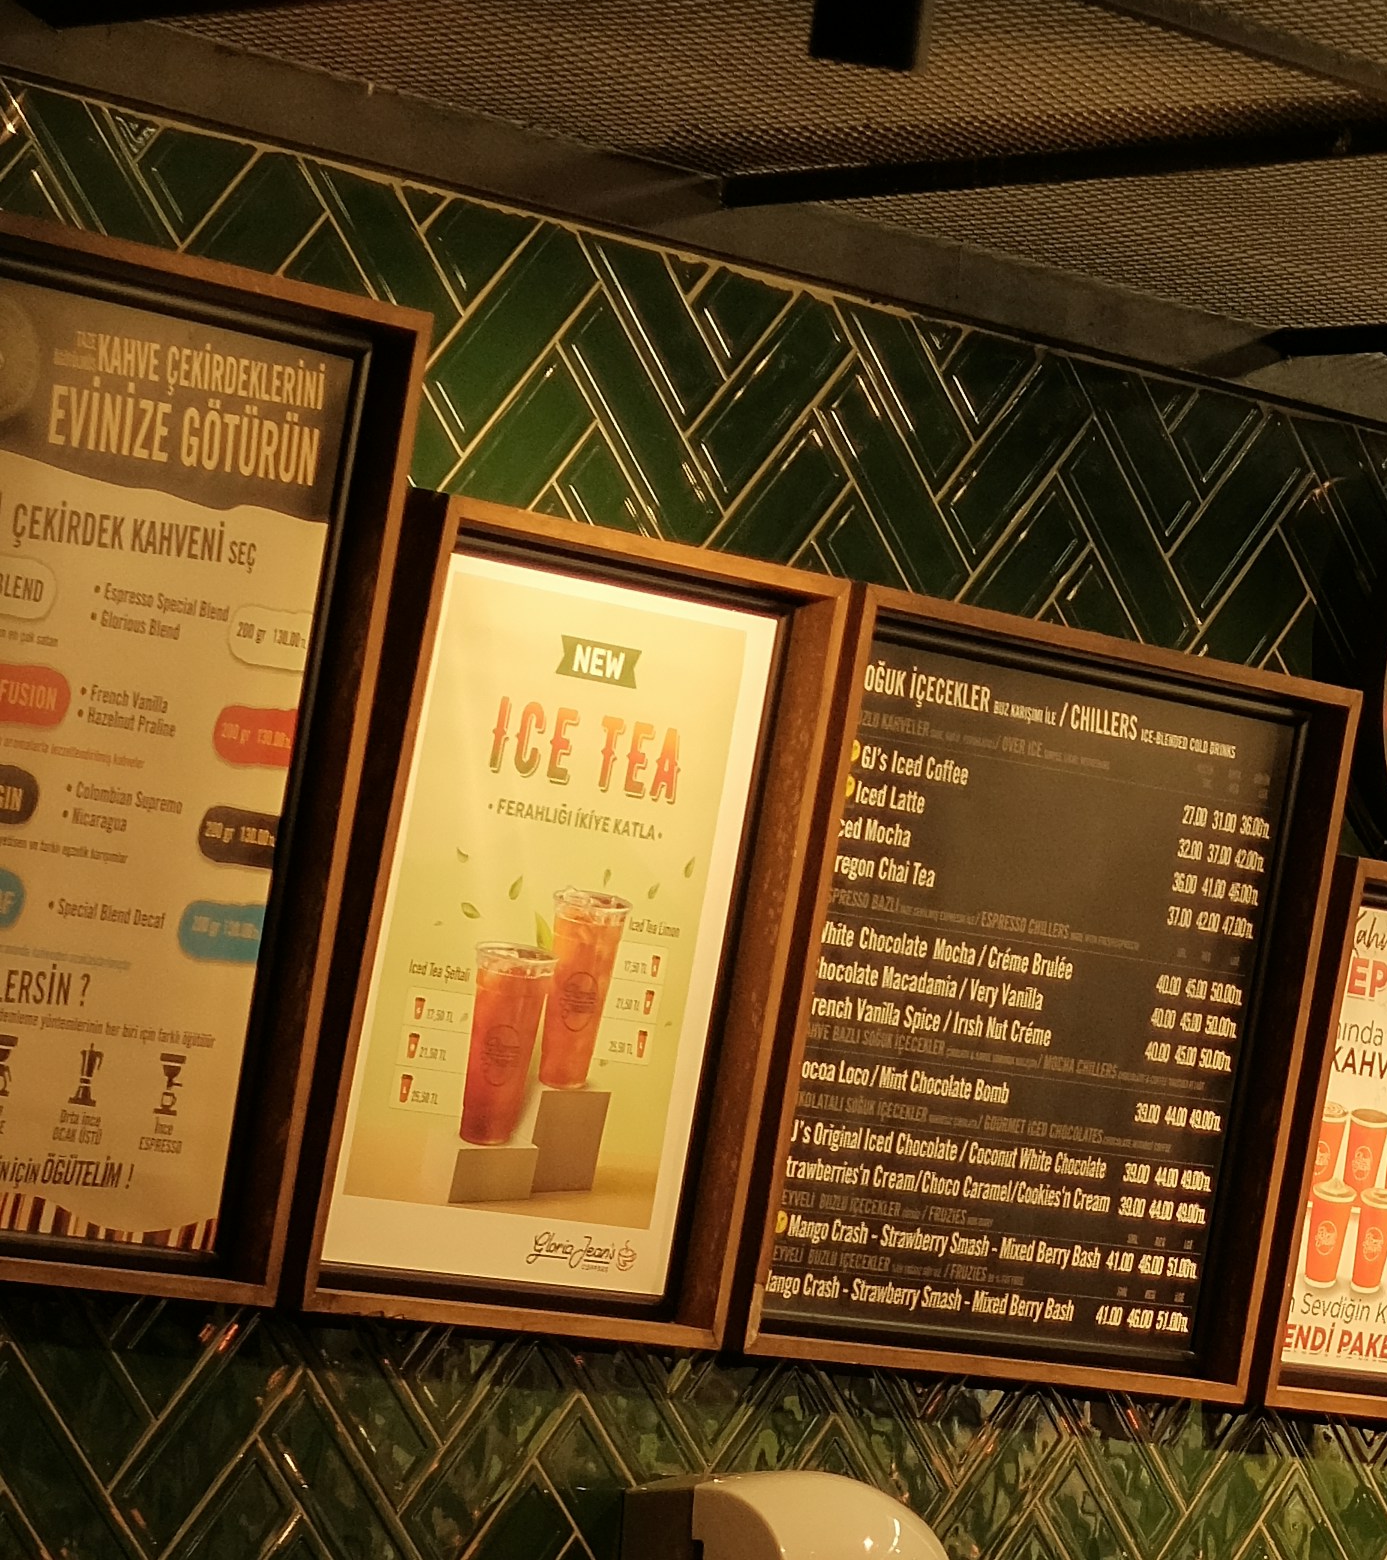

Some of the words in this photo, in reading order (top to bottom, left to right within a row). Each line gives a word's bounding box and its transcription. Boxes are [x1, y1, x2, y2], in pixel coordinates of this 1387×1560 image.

[98, 333, 160, 381] KAHVE
[167, 343, 326, 410] ÇEKİRDEKLERİNİ
[48, 376, 172, 462] EVİNİZE
[181, 399, 320, 487] GÖTÜRÜN
[12, 500, 126, 550] ÇEKİRDEK
[131, 517, 226, 563] KAHVENİ
[228, 540, 257, 574] SEÇ
[103, 583, 154, 608] Espresso
[157, 592, 197, 617] Special
[199, 600, 230, 623] Blend
[100, 611, 147, 635] Glorious
[149, 618, 180, 641] Blend
[572, 643, 625, 680] NEW
[87, 707, 135, 731] Hazelnut
[90, 685, 129, 707] French
[132, 691, 169, 715] Vanilla
[863, 660, 907, 698] OĞUK
[910, 666, 991, 713] İÇECEKLER
[1070, 704, 1138, 741] CHILLERS
[489, 696, 580, 785] ICE
[598, 715, 681, 805] TEA
[861, 745, 888, 772] GJ's
[891, 750, 924, 777] Iced
[925, 757, 969, 786] Coffee
[854, 780, 886, 807] Iced
[889, 786, 926, 814] Latte
[72, 808, 128, 833] Nicaragua
[613, 818, 656, 840] KATLA
[865, 818, 911, 848] Mocha
[834, 854, 875, 880] regon
[878, 856, 910, 884] Chai
[913, 862, 936, 888] Tea
[57, 898, 97, 920] Special
[100, 903, 131, 925] Blend
[132, 909, 166, 929] Decaf
[859, 925, 927, 959] Chocolate
[932, 938, 975, 966] Mocha
[1031, 951, 1073, 980] Brulée
[816, 957, 879, 987] hocolate
[881, 964, 957, 999] Macadamia
[970, 978, 999, 1009] Very
[1001, 982, 1044, 1011] Vanilla
[811, 993, 851, 1020] rench
[856, 997, 901, 1027] Vanilla
[903, 1005, 941, 1035] Spice
[953, 1011, 983, 1037] Irish
[986, 1017, 1007, 1041] Nut
[800, 1059, 835, 1082] ocoa
[838, 1060, 869, 1087] Loco
[879, 1065, 907, 1092] Mint
[910, 1070, 973, 1100] Chocolate
[974, 1078, 1010, 1104] Bomb
[791, 1119, 811, 1143] J's
[813, 1121, 863, 1152] Original
[864, 1128, 895, 1154] Iced
[896, 1132, 958, 1162] Chocolate
[969, 1141, 1017, 1169] Coconut
[1019, 1147, 1052, 1172] White
[1054, 1151, 1107, 1179] Chocolate
[41, 1153, 122, 1188] ÖĞÜTELİM
[1073, 1187, 1111, 1213] Cream
[788, 1213, 829, 1244] Mango
[831, 1218, 869, 1245] Crash
[880, 1223, 949, 1258] Strawberry
[950, 1232, 990, 1257] Smash
[999, 1236, 1034, 1261] Mixed
[1036, 1241, 1071, 1270] Berry
[1072, 1245, 1101, 1269] Bash
[803, 1273, 840, 1300] Crash
[851, 1277, 921, 1311] Strawberry
[921, 1285, 962, 1311] Smash
[972, 1289, 1006, 1316] Mixed
[1009, 1294, 1044, 1323] Berry
[1044, 1297, 1075, 1323] Bash
[1301, 1293, 1370, 1324] Sevdiğin
[1283, 1322, 1335, 1353] ENDİ
